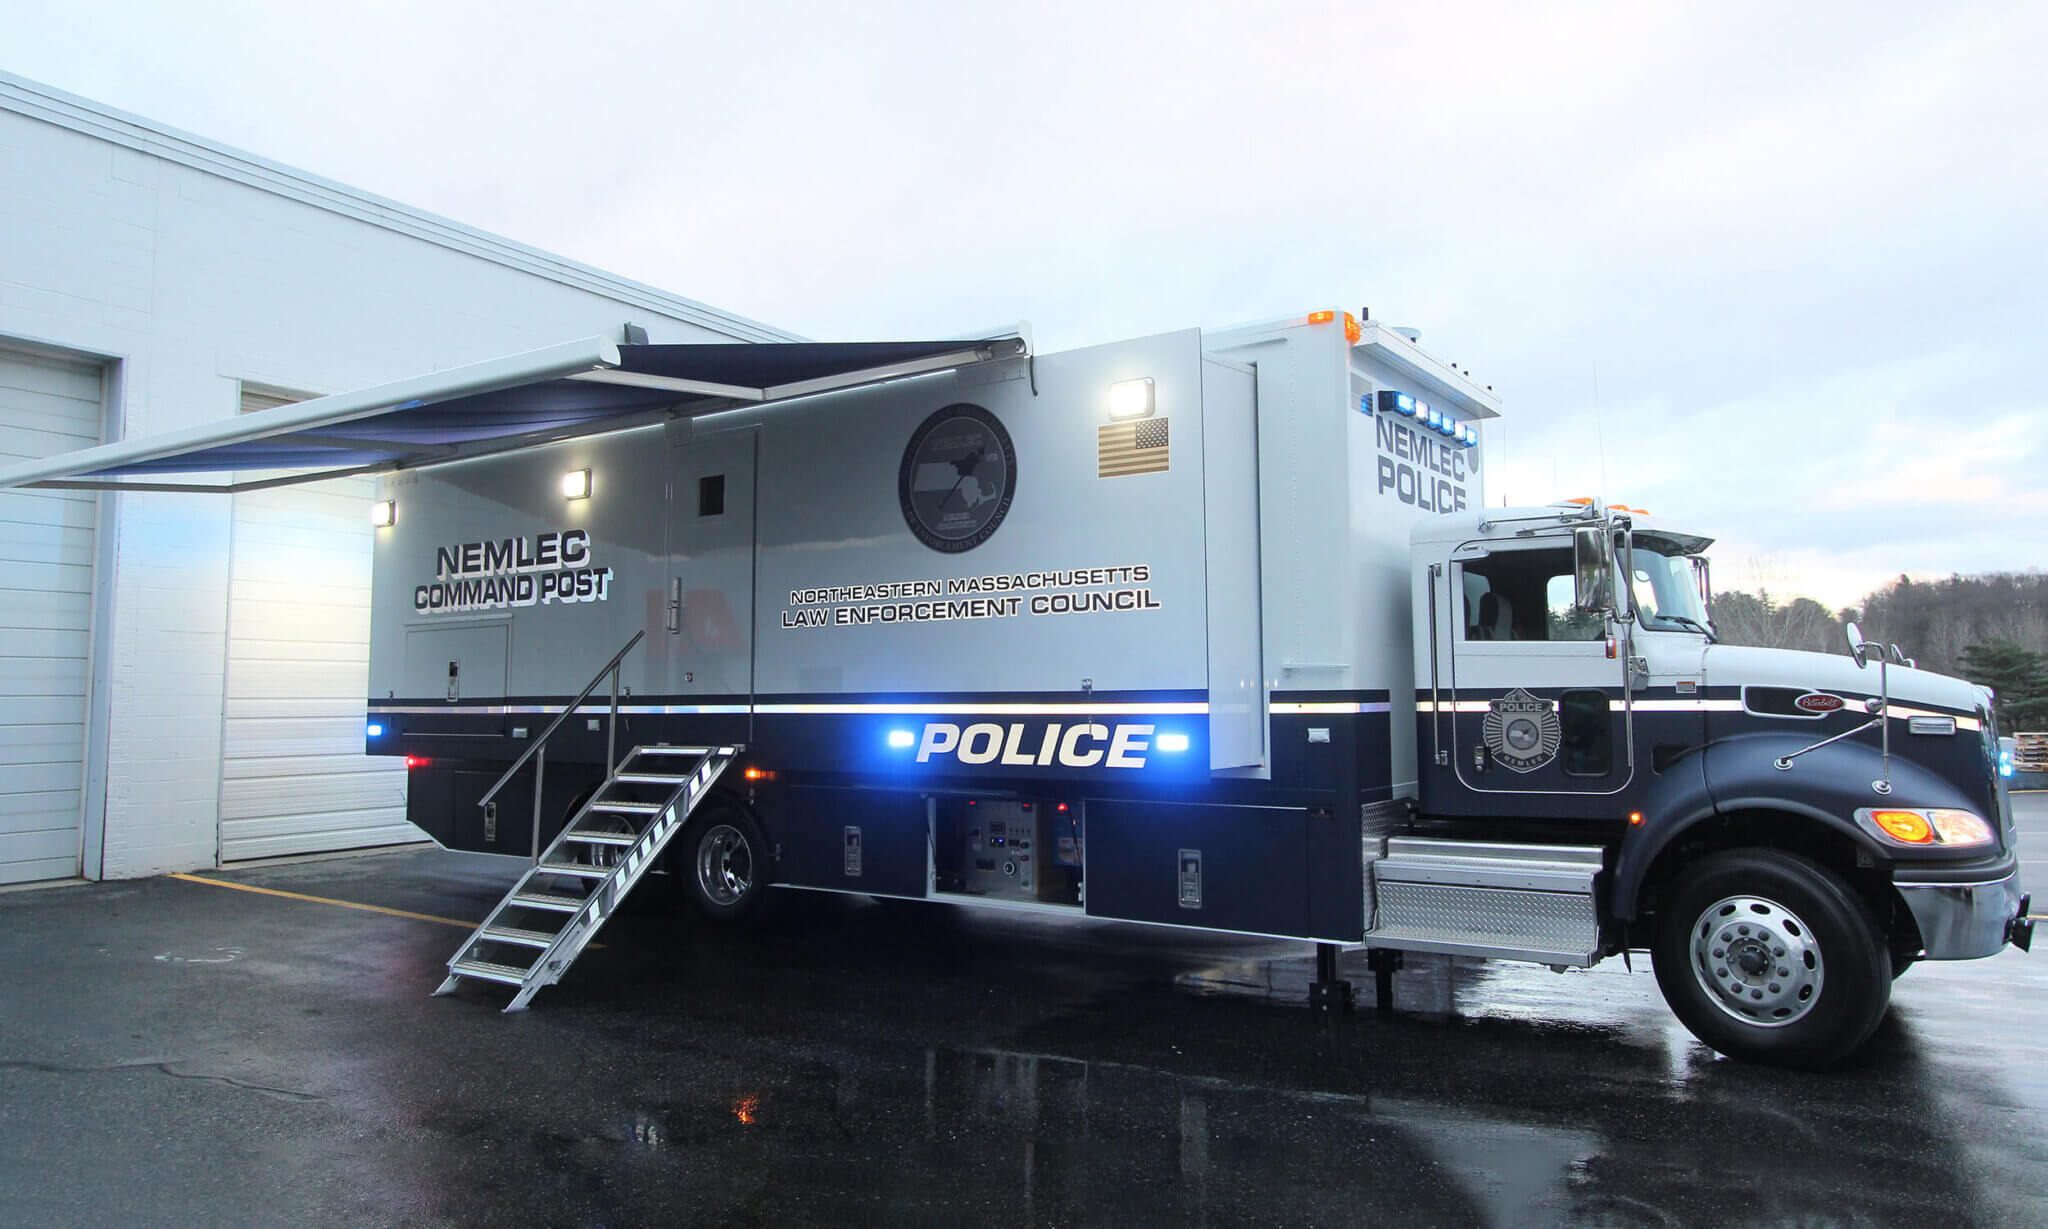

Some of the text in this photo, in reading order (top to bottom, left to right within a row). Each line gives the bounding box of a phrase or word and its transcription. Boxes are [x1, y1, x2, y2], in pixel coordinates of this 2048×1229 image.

[1375, 414, 1465, 483] NEMLEC
[1377, 454, 1467, 515] POLICE
[436, 528, 591, 581] NEMLEC
[414, 566, 614, 615] COMMAND POST
[790, 563, 1152, 607] NORTHEASTERN MASSACHUSETTS
[781, 588, 1161, 630] LAW ENFORCEMENT COUNCIL
[1500, 703, 1543, 712] POLICE
[915, 723, 1156, 769] POLICE
